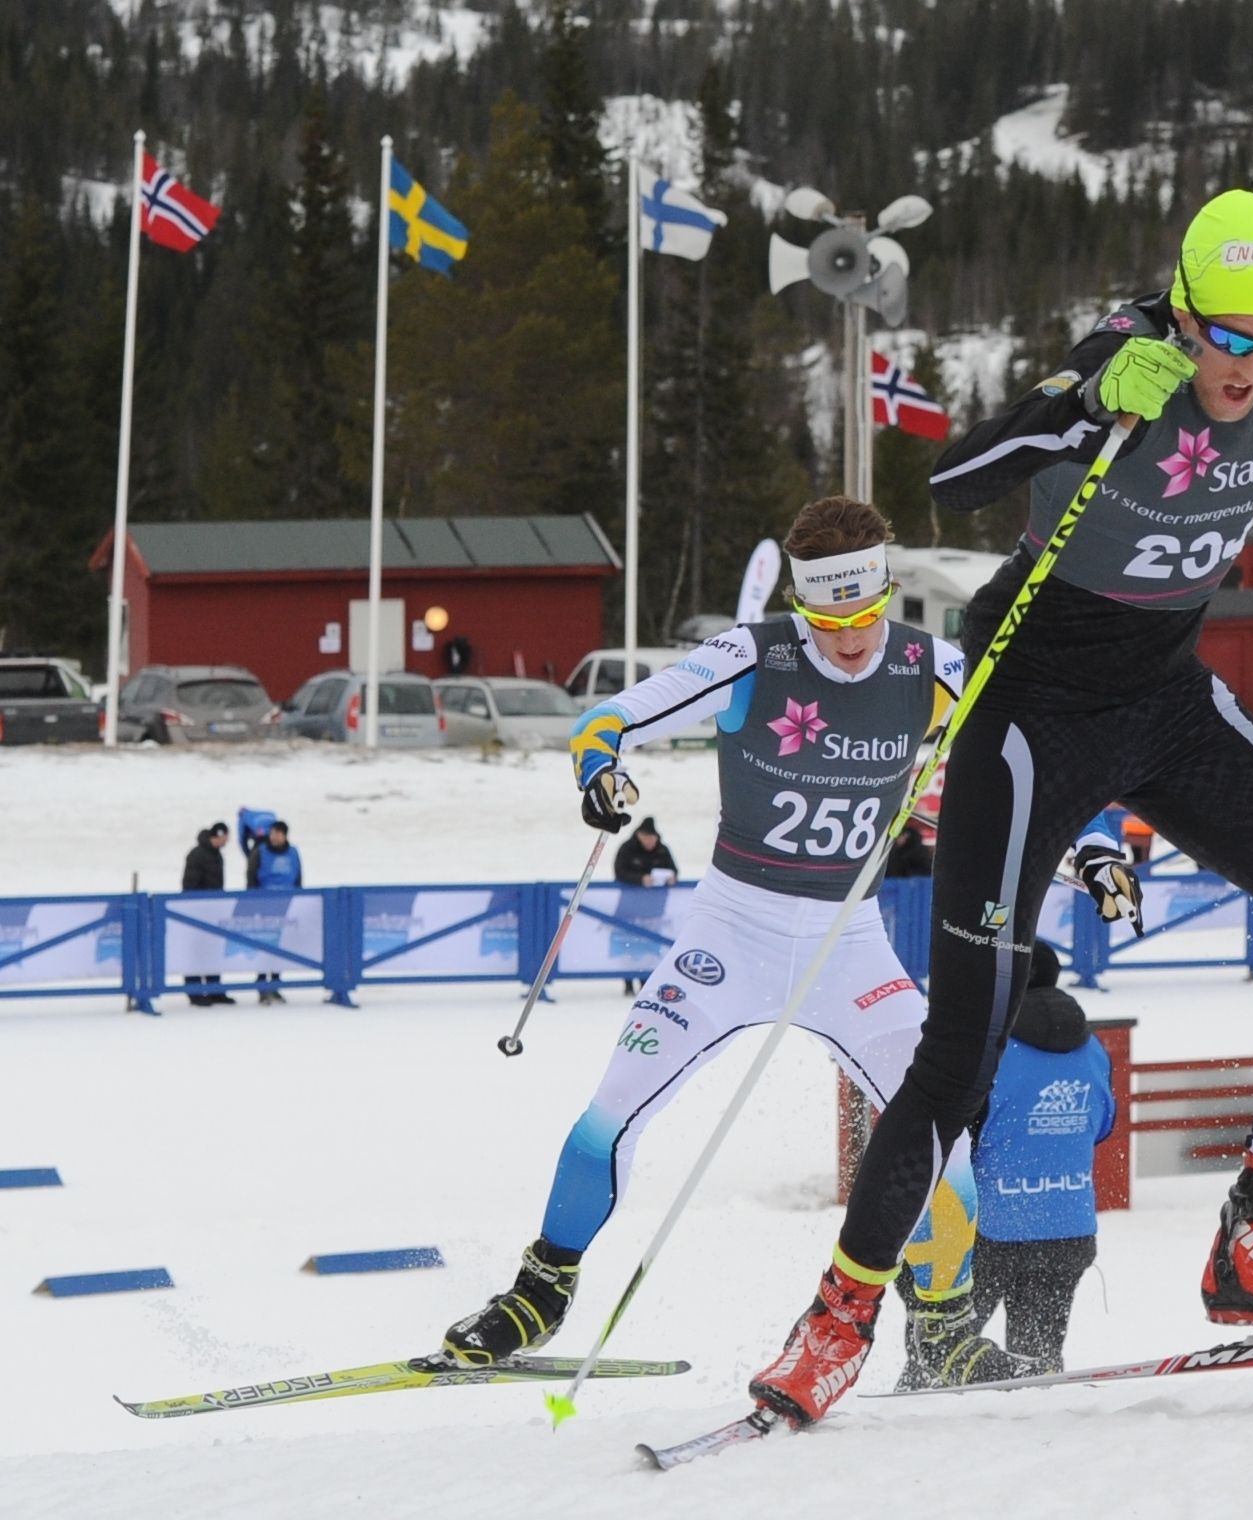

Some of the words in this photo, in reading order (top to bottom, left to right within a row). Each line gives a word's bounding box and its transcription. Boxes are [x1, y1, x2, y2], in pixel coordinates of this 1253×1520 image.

[1120, 497, 1183, 525] støtter
[805, 566, 867, 584] VATTENFALL
[888, 662, 921, 676] Statoil
[821, 733, 909, 762] Statoil
[755, 757, 799, 781] støtter
[763, 790, 881, 859] 258
[942, 919, 989, 947] Stadsbygd
[857, 984, 897, 1007] TEAM
[617, 1021, 659, 1055] life
[1028, 1115, 1088, 1128] NORGES
[224, 1373, 333, 1401] FISCHER
[426, 1372, 498, 1388] FISCHER
